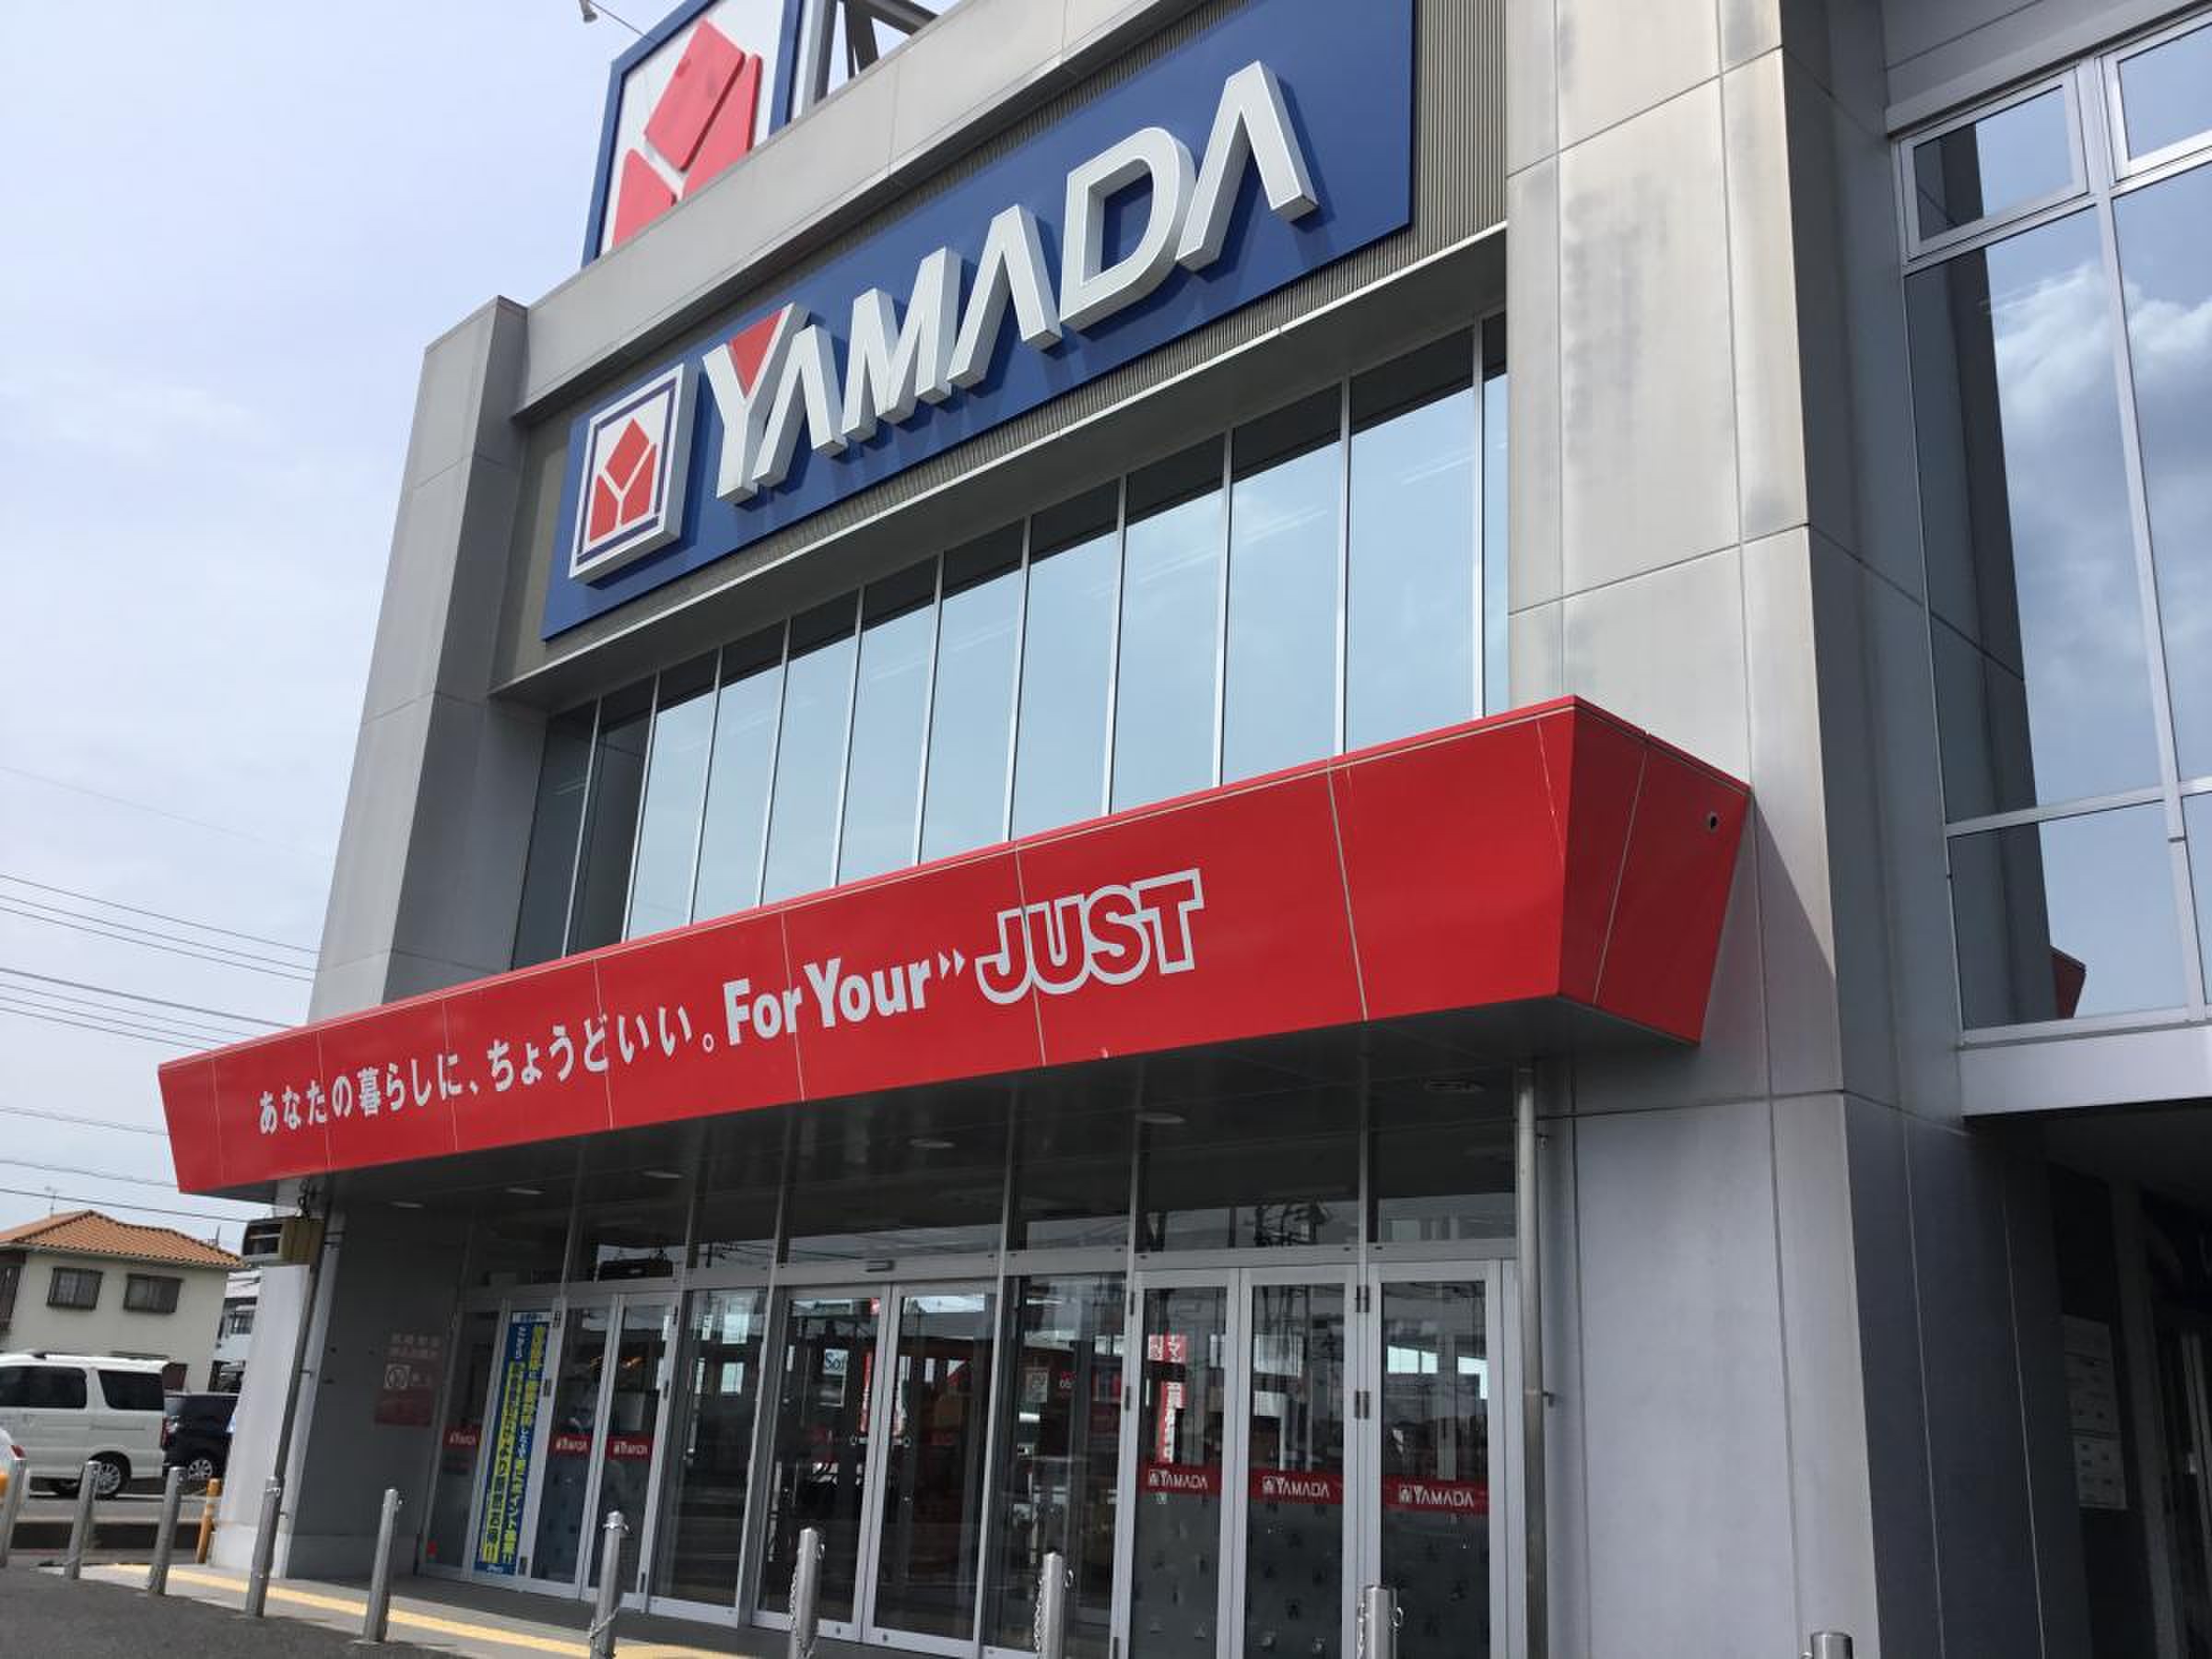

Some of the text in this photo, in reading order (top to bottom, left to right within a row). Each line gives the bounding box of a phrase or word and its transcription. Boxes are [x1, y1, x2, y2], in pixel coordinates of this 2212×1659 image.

[702, 61, 1319, 504] YAMADA
[724, 868, 1205, 1046] For Your JUST
[1159, 1469, 1208, 1490] YAMADA
[1277, 1477, 1330, 1499] YAMADA
[1413, 1485, 1475, 1508] YAMADA
